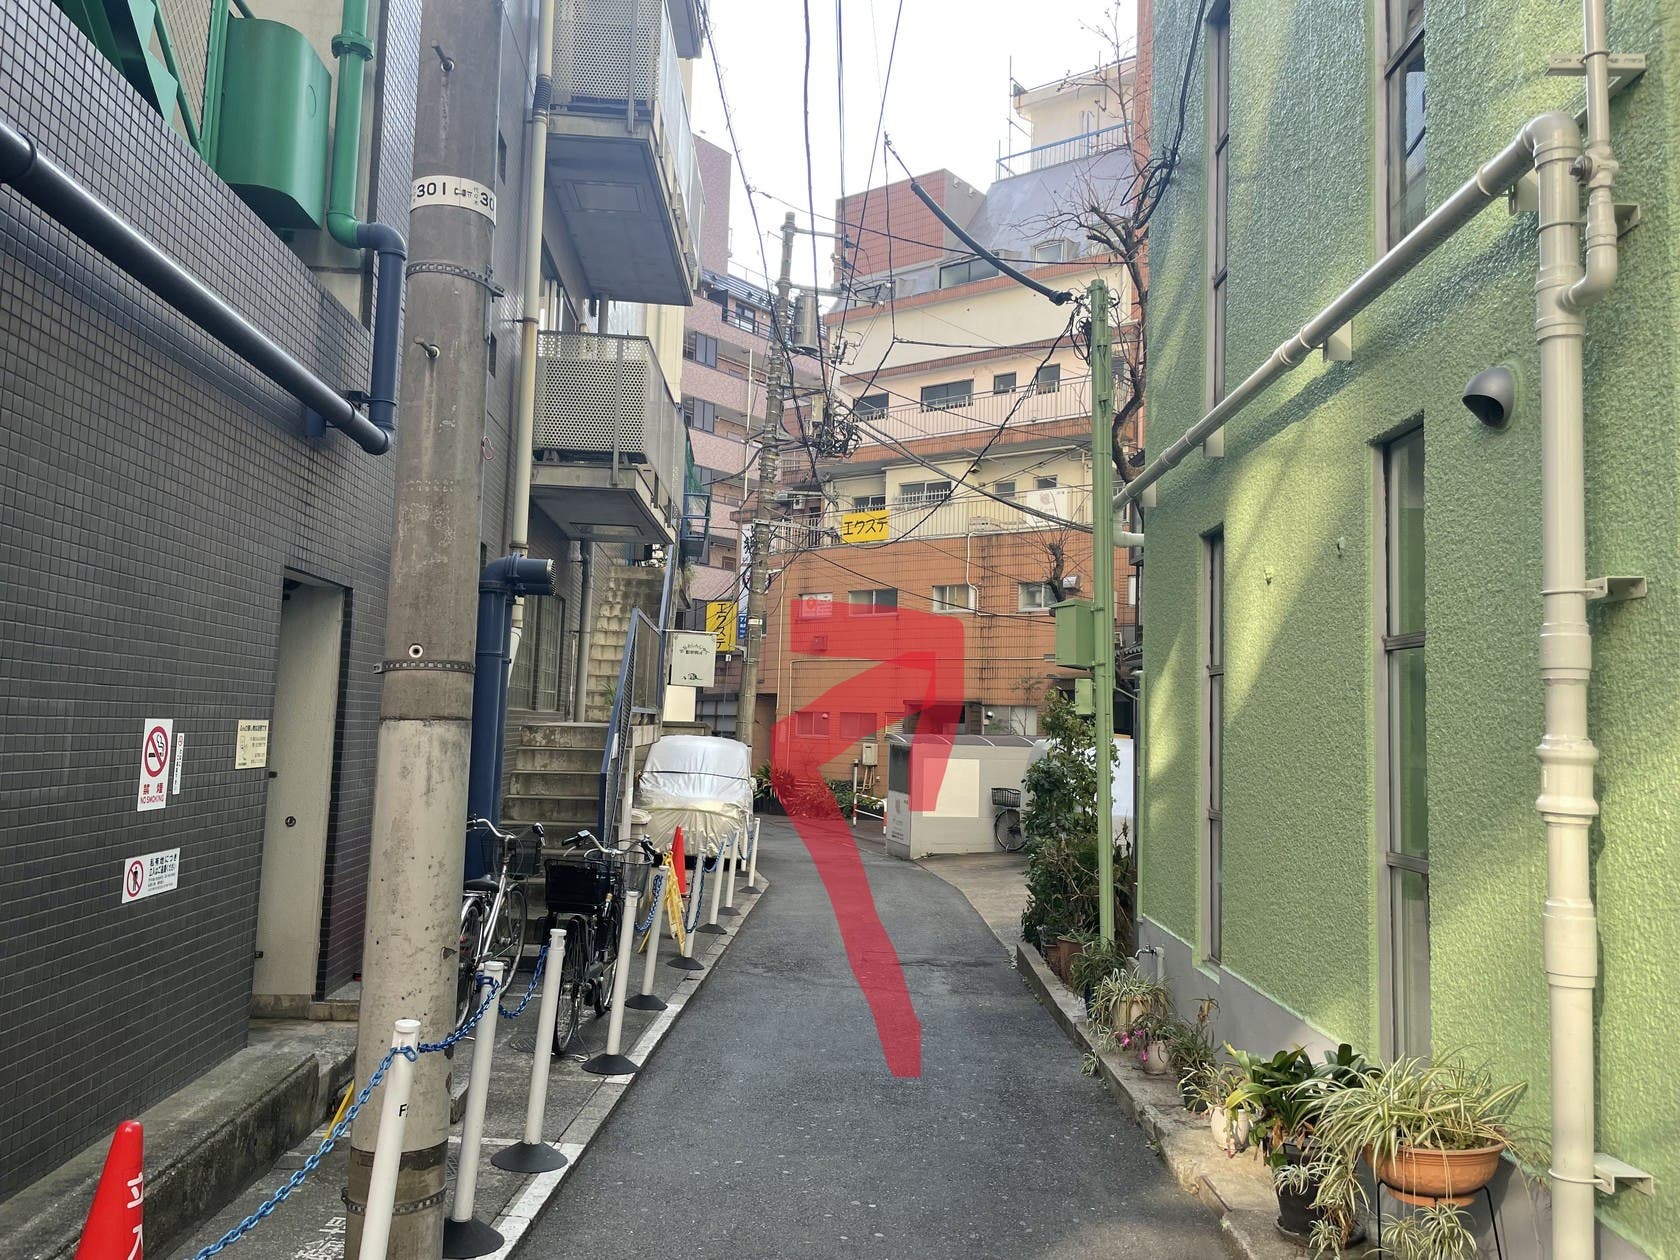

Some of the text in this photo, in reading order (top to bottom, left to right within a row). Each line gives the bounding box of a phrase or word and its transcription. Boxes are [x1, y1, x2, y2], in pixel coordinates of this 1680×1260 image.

[416, 182, 446, 198] 301
[843, 517, 888, 536] エクステ
[713, 603, 727, 649] エクステ
[142, 782, 164, 795] 禁煙
